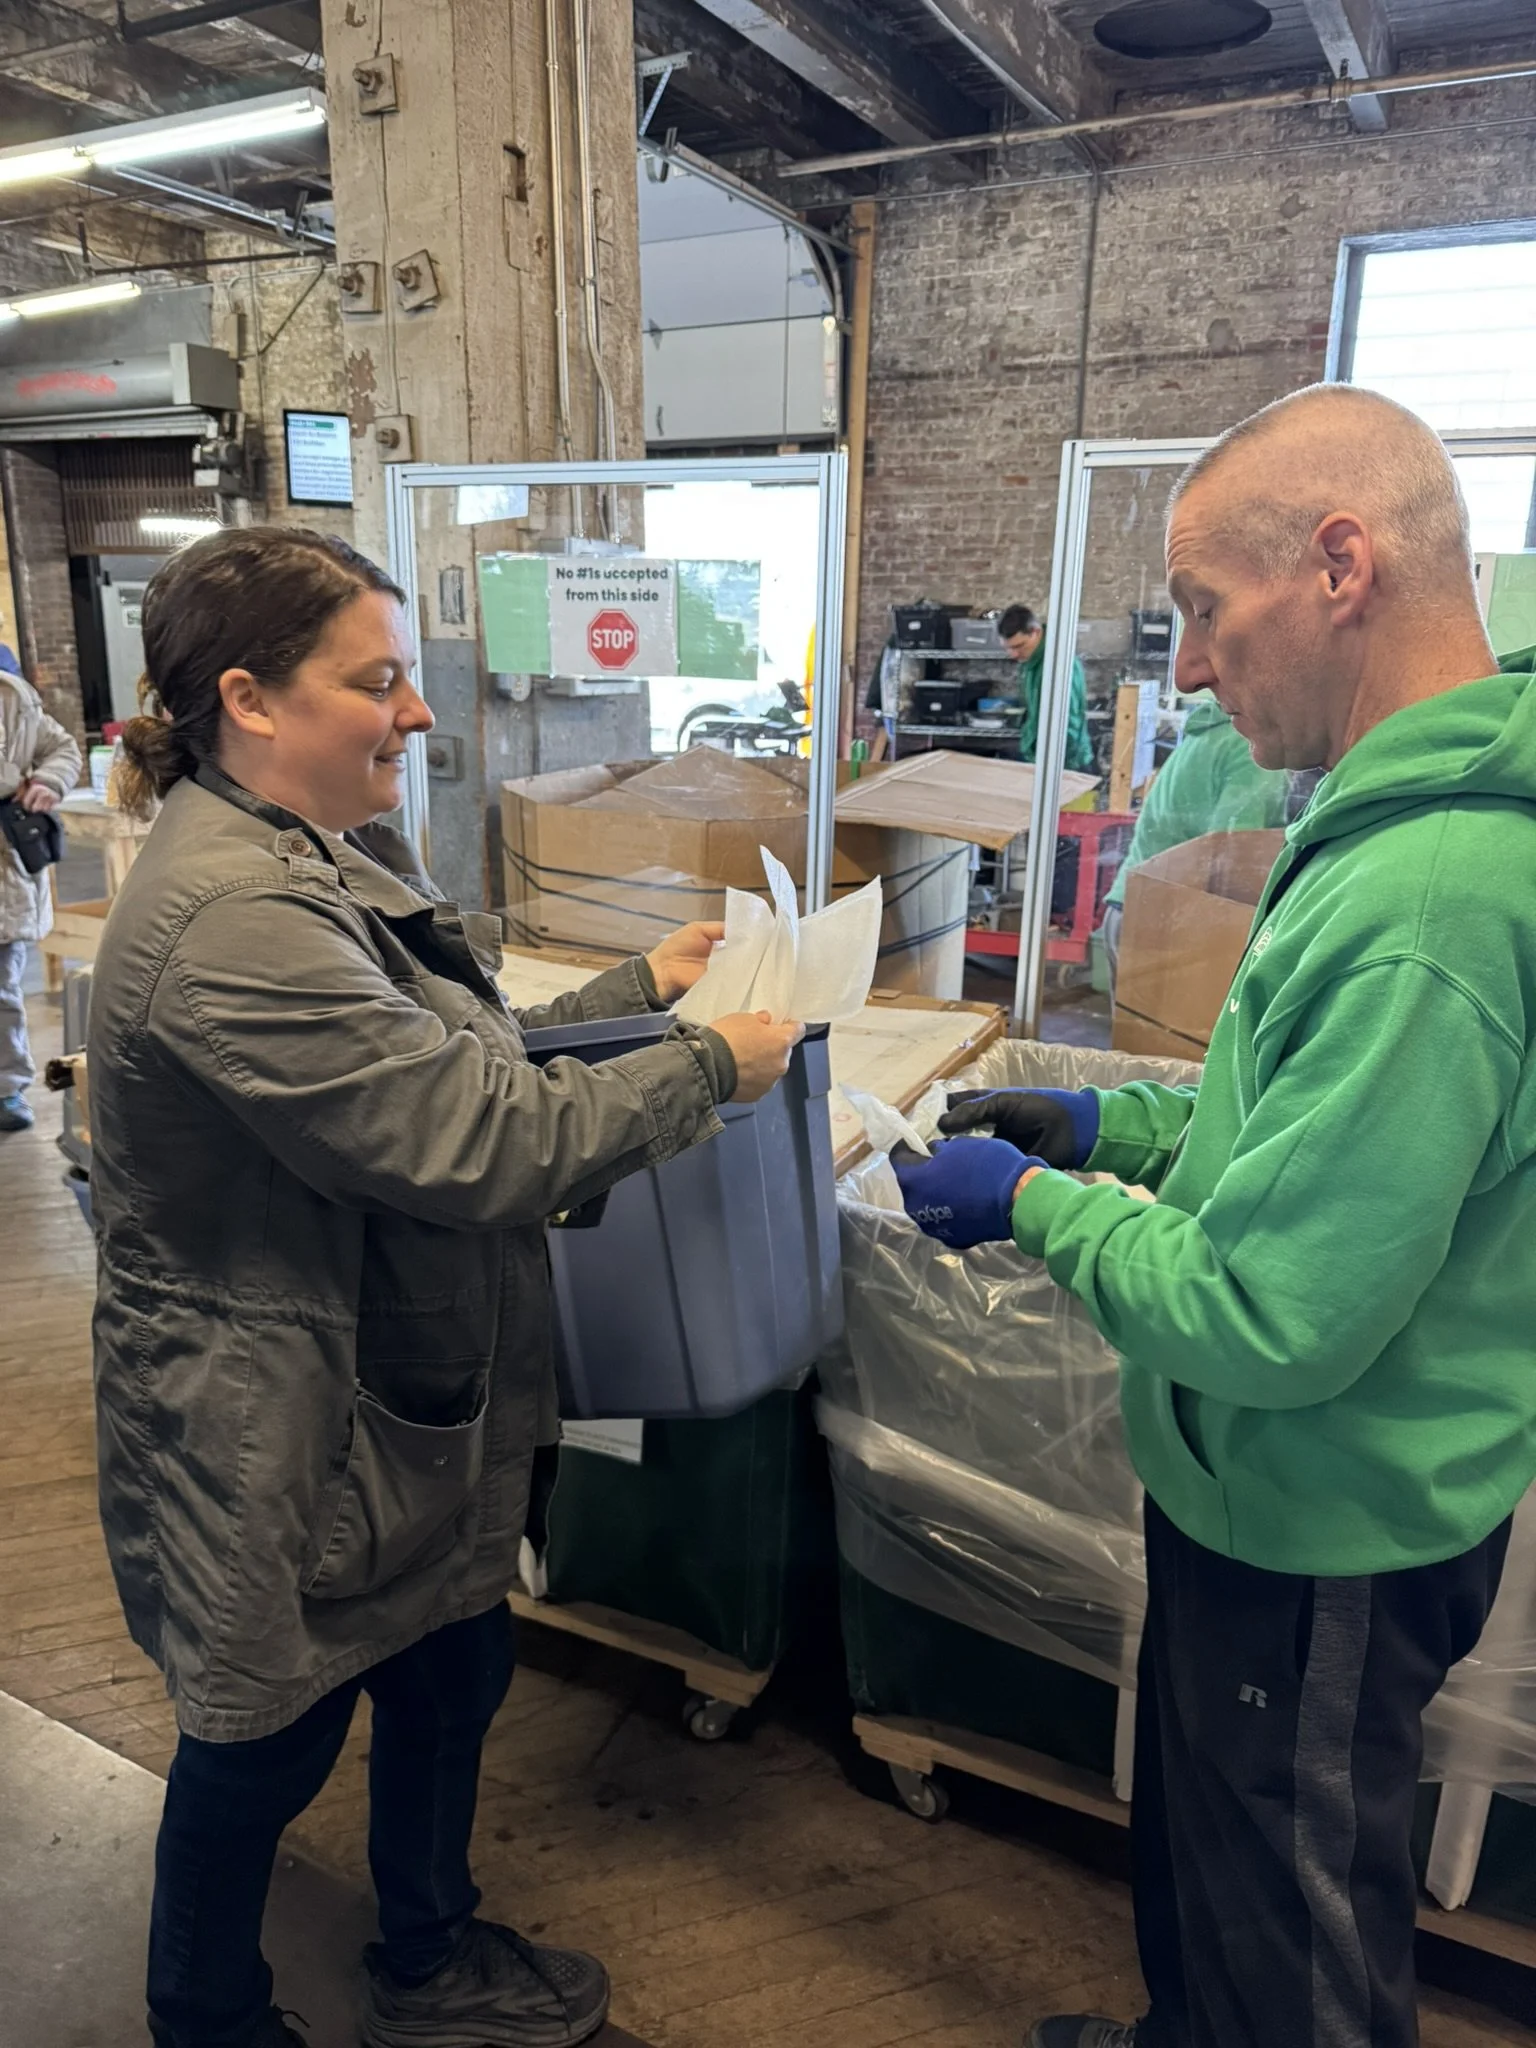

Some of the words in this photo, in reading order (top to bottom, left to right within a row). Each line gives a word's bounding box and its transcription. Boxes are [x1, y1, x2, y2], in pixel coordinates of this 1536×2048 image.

[556, 567, 574, 580] No
[577, 567, 600, 580] #1s
[603, 567, 668, 584] accepted
[566, 588, 599, 601] from
[601, 588, 628, 601] this
[630, 588, 659, 601] side
[592, 628, 634, 649] STOP
